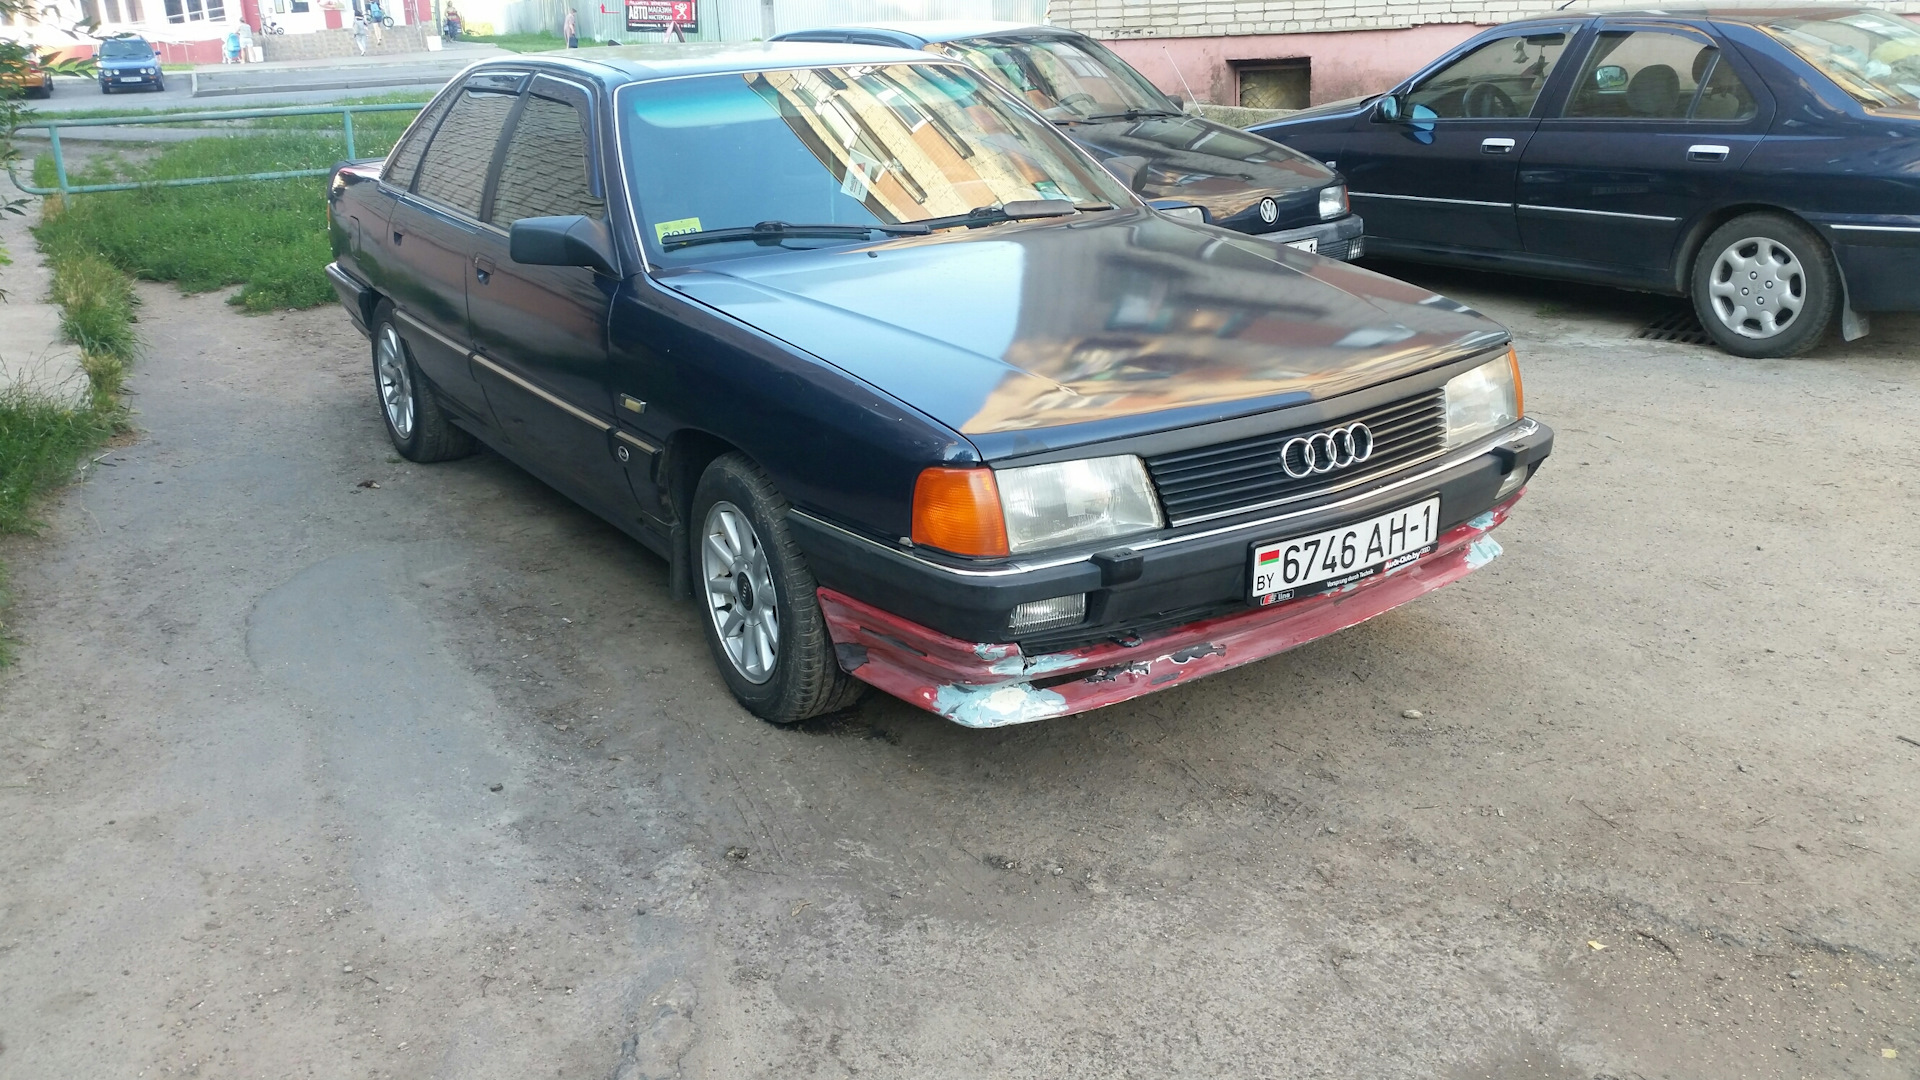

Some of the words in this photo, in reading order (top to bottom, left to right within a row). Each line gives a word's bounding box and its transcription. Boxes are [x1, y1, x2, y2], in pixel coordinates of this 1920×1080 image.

[629, 6, 647, 19] АВТО
[1283, 531, 1357, 584] 6746
[1365, 505, 1431, 563] AH-1
[1256, 573, 1275, 591] BY
[1327, 577, 1347, 587] Vorsprung
[1348, 574, 1359, 582] durch
[1360, 569, 1374, 577] Technik
